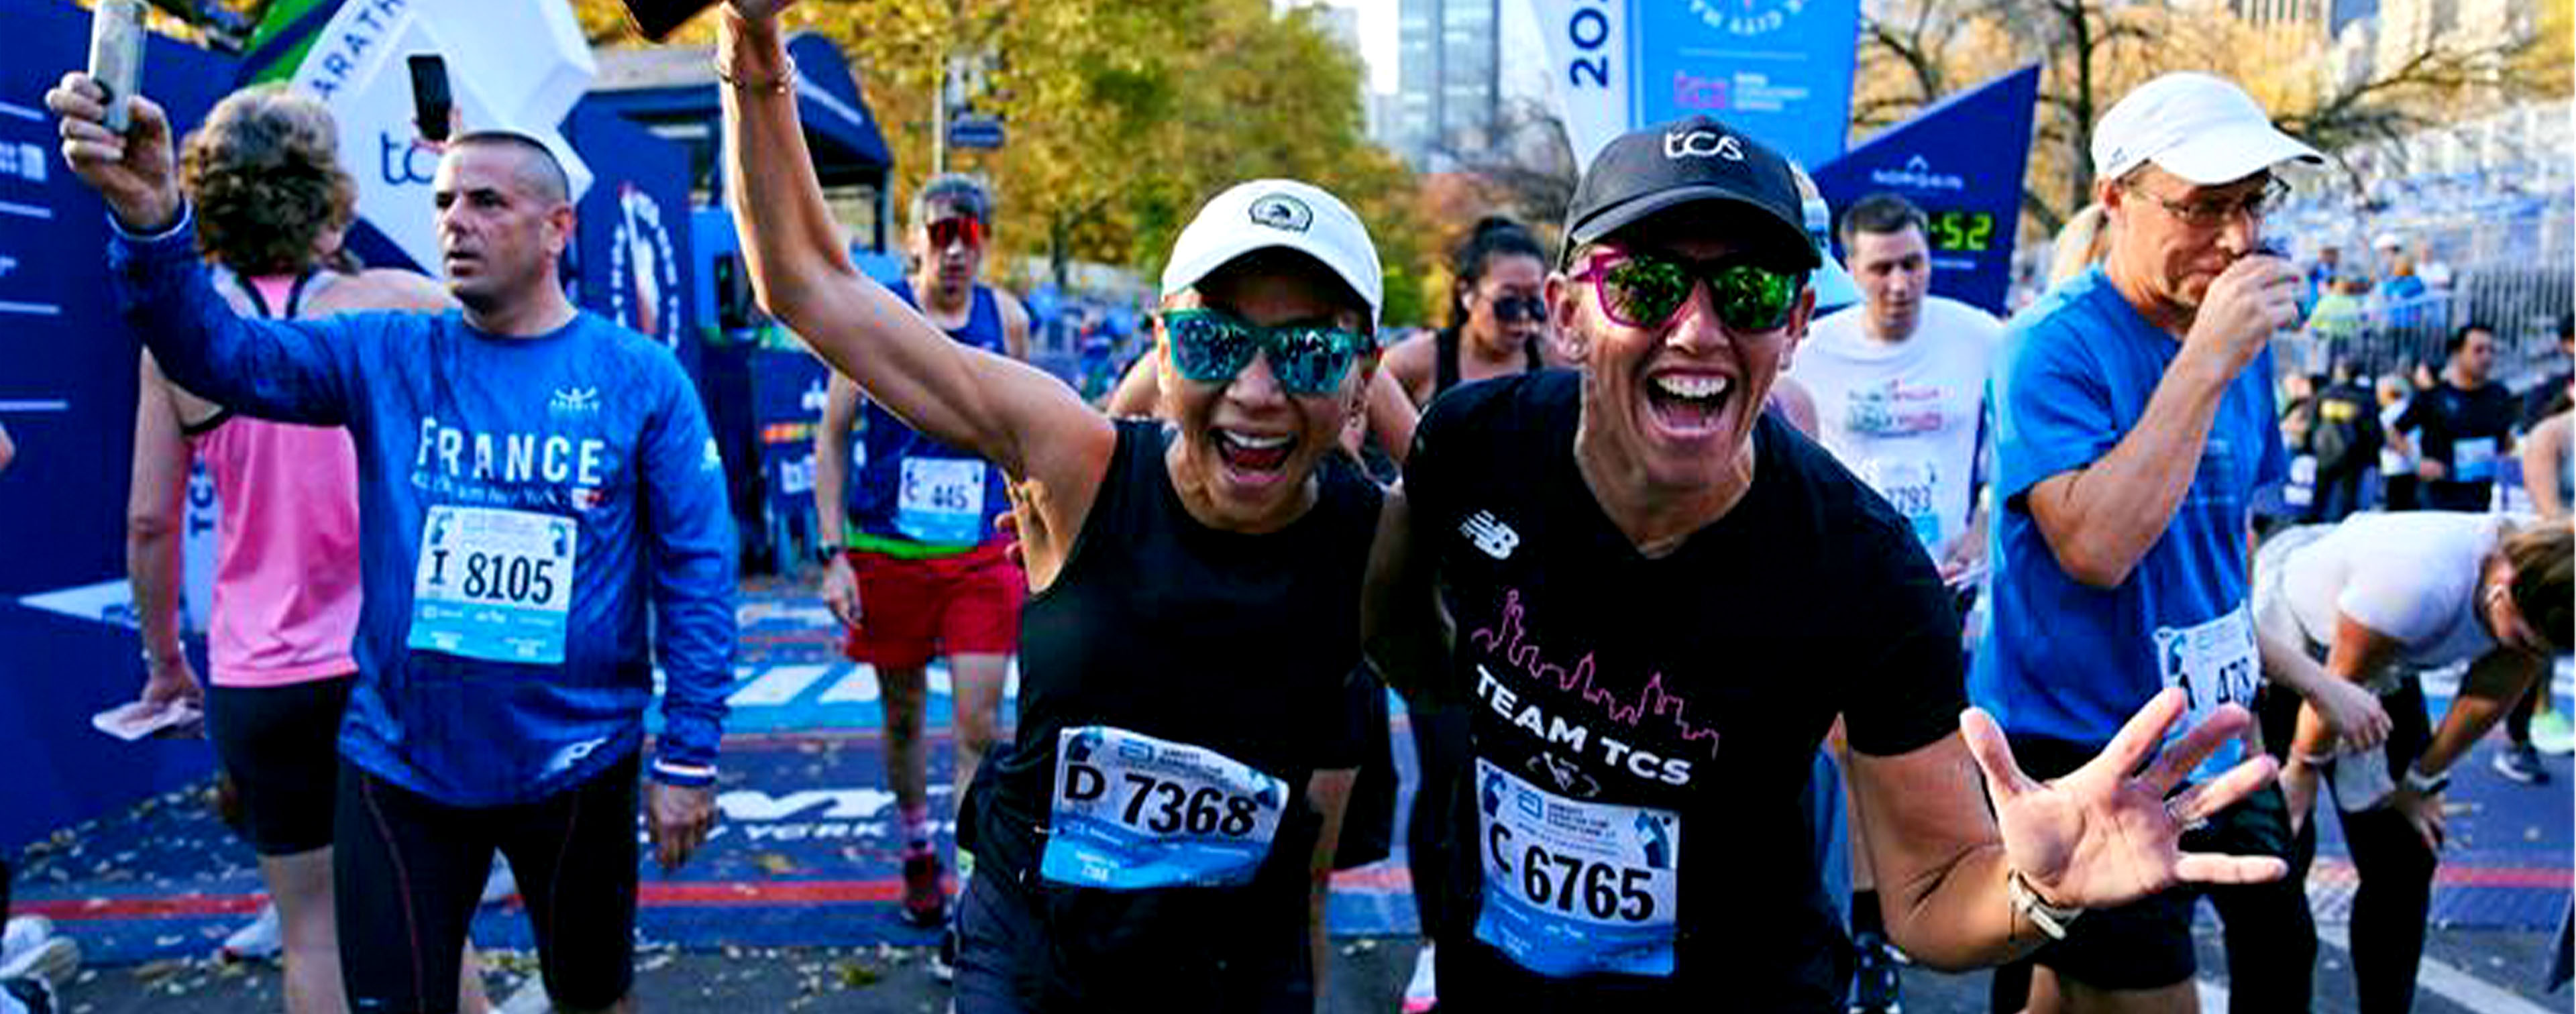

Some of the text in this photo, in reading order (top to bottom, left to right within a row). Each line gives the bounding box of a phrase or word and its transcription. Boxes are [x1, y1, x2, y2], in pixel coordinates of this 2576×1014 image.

[1664, 130, 1743, 161] tcs
[417, 416, 605, 486] FRANCE
[463, 551, 555, 605] 8105
[1477, 663, 1693, 786] TEAM TCS
[1064, 764, 1106, 800] D
[1122, 773, 1259, 837] 7368
[1489, 822, 1512, 872] C
[1523, 845, 1655, 922] 6765
